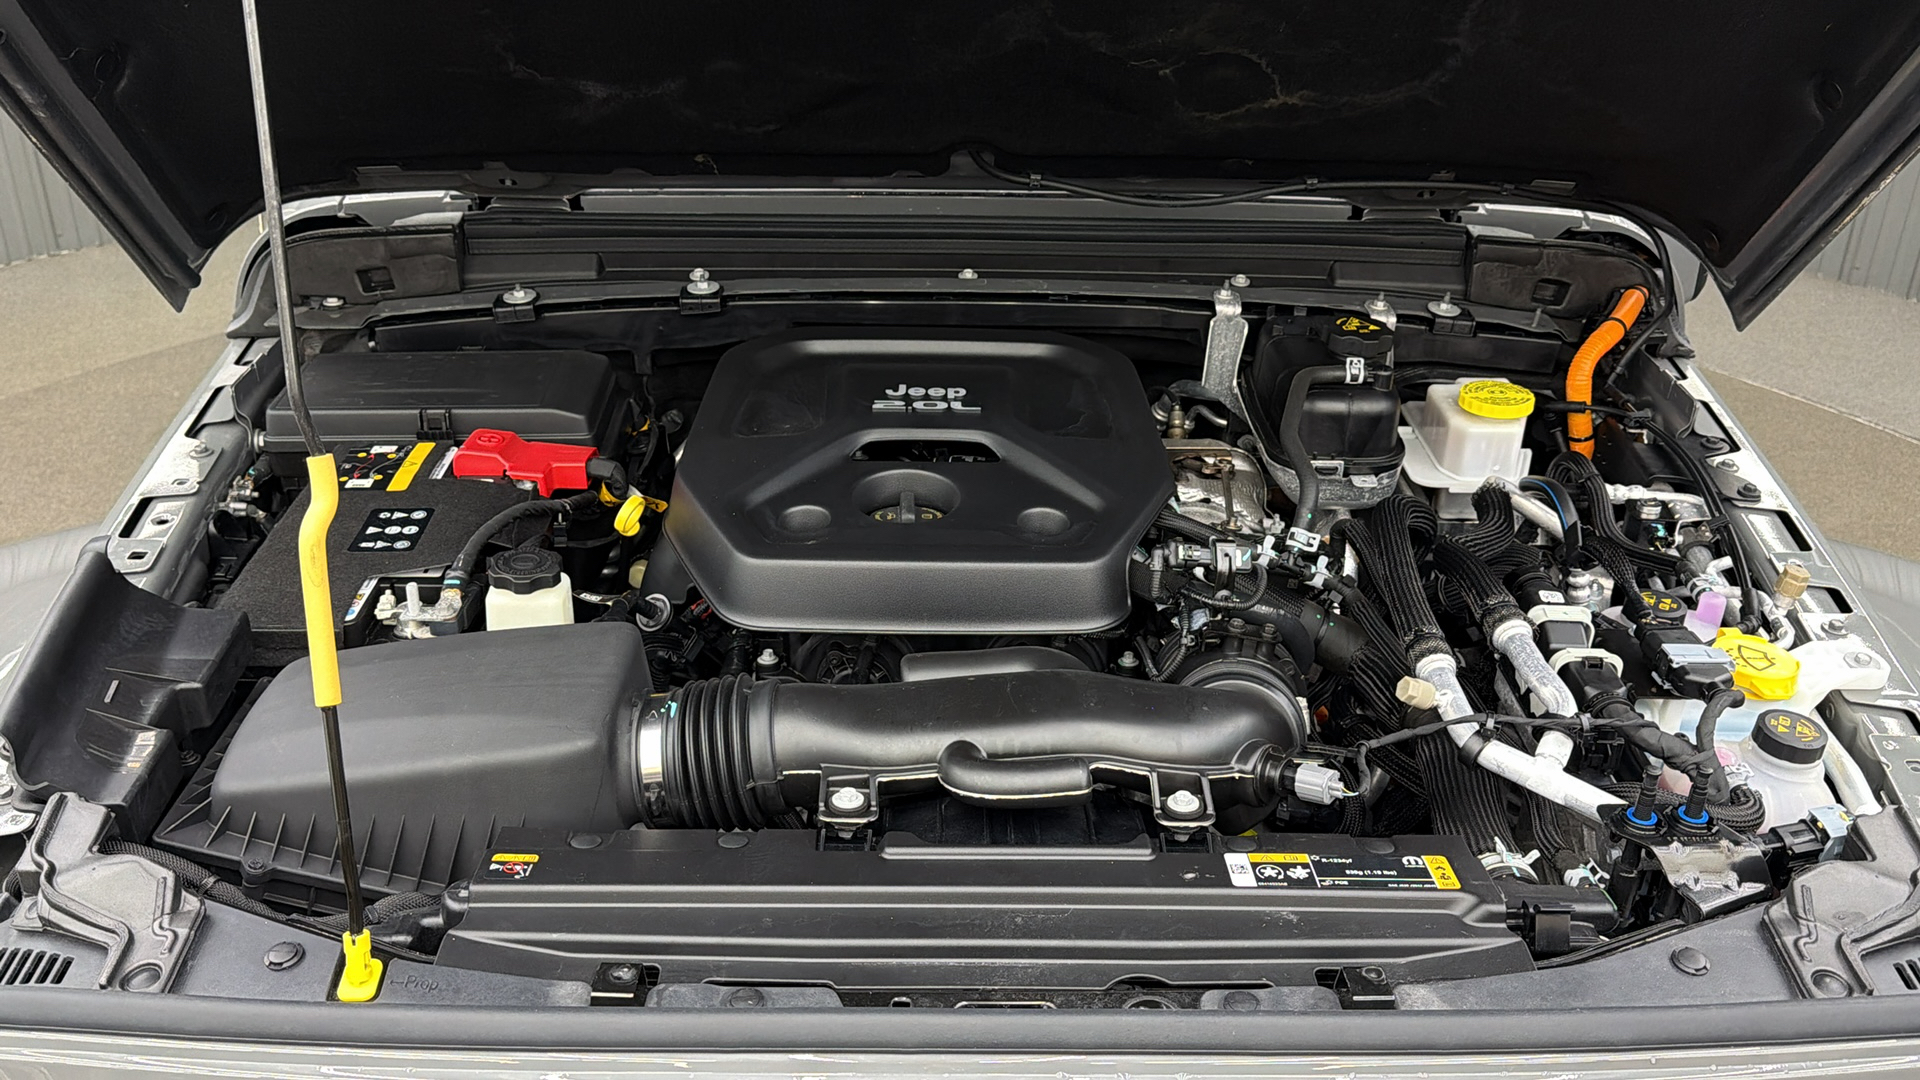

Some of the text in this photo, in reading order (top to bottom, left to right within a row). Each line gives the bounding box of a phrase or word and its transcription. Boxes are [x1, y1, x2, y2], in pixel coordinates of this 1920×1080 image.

[884, 384, 967, 400] Jeep
[872, 400, 982, 413] 2.0L
[405, 975, 439, 993] Prop
